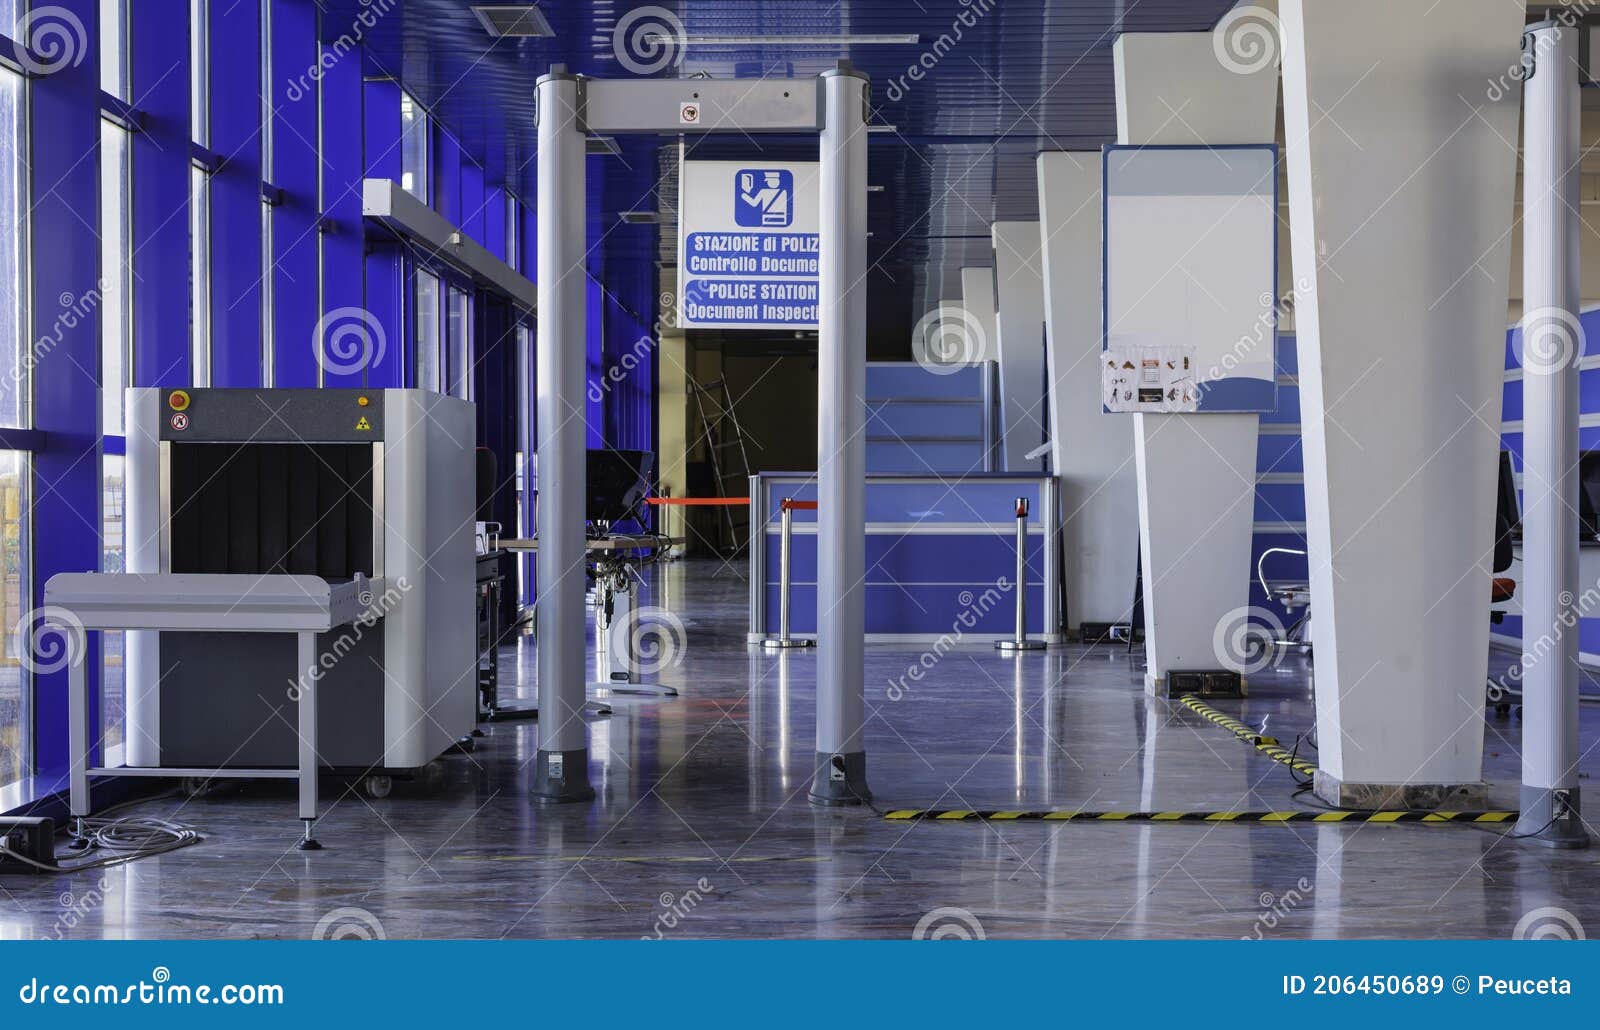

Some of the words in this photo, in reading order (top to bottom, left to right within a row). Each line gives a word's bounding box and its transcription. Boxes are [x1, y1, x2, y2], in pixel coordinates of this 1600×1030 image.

[694, 236, 759, 252] STAZIONE
[763, 237, 777, 251] di
[781, 237, 819, 253] POLIZ
[691, 256, 757, 272] Controllo
[761, 257, 820, 272] Docume
[709, 284, 756, 299] POLICE
[761, 285, 817, 300] STATION
[688, 303, 759, 319] Document
